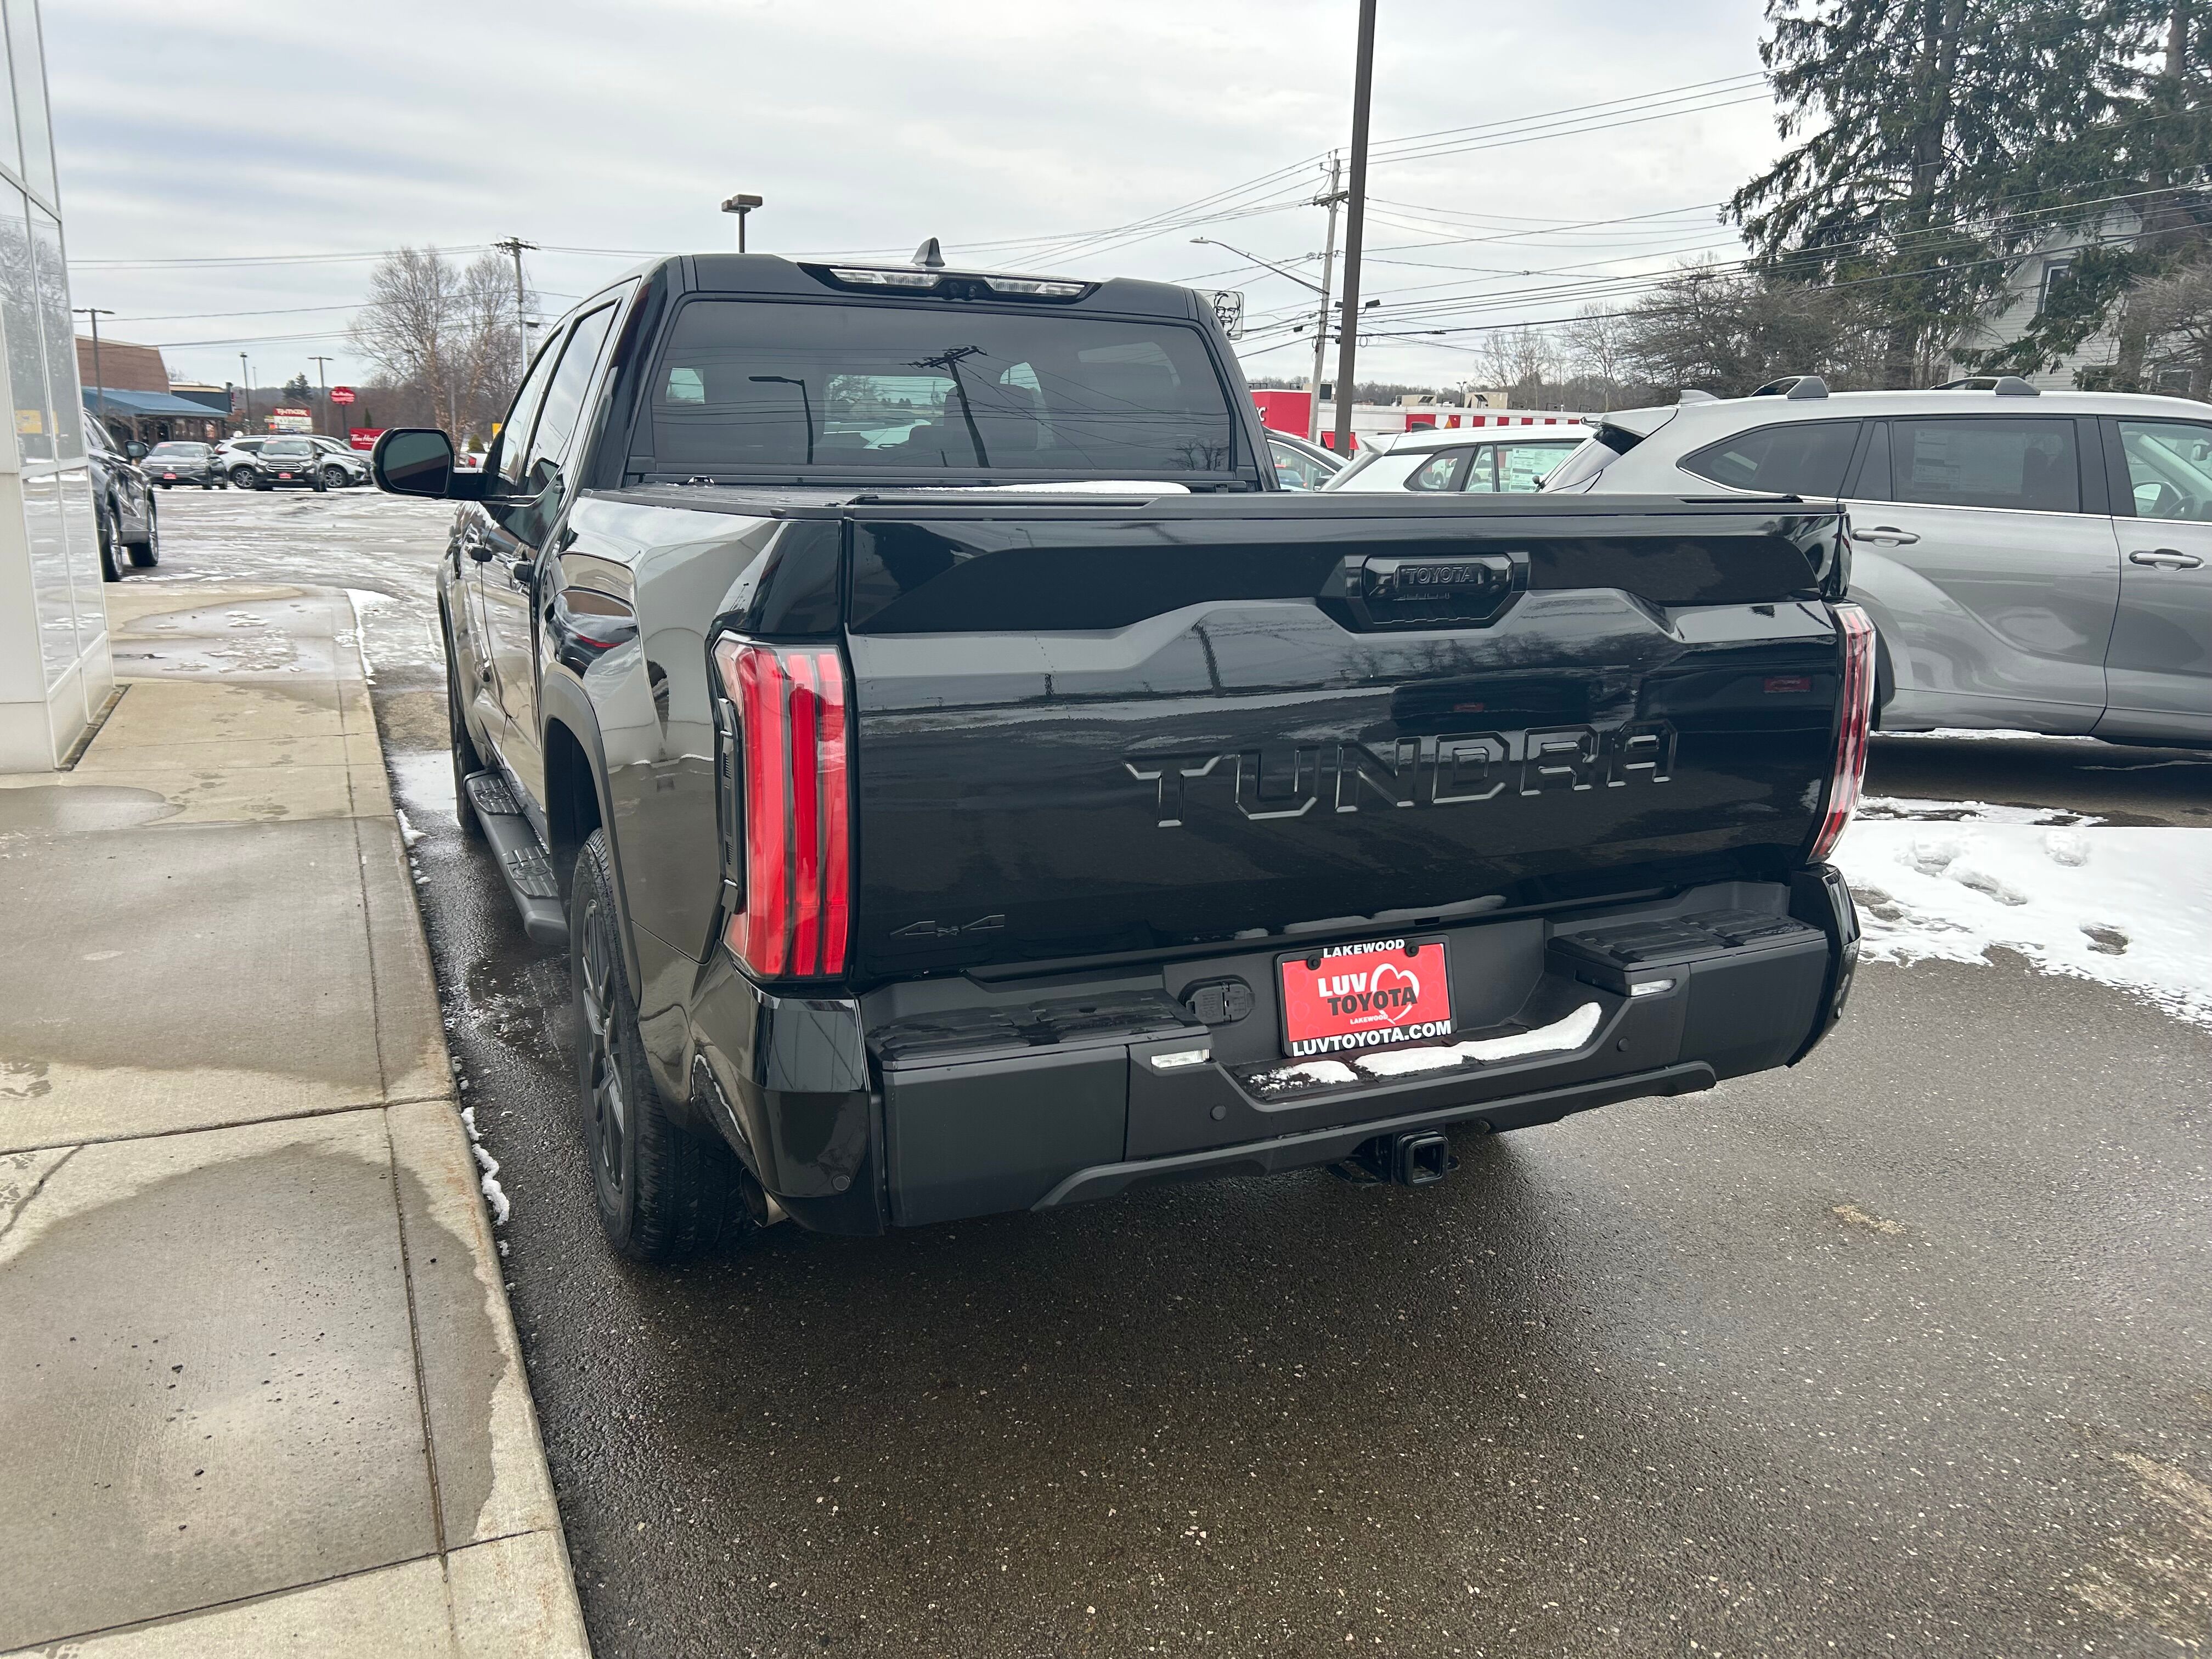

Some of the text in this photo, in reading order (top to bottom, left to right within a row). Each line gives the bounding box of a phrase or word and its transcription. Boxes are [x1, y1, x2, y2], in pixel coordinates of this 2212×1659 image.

[1406, 566, 1474, 584] TOYOTA
[1122, 718, 1678, 828] TUNDRA
[1323, 939, 1405, 958] LAKEWOOD
[1317, 972, 1367, 997] LUV
[1327, 986, 1417, 1015] TOYOTA
[1350, 1013, 1389, 1025] LAKEWOOD
[1292, 1020, 1451, 1057] LUVTOYOTA.COM
